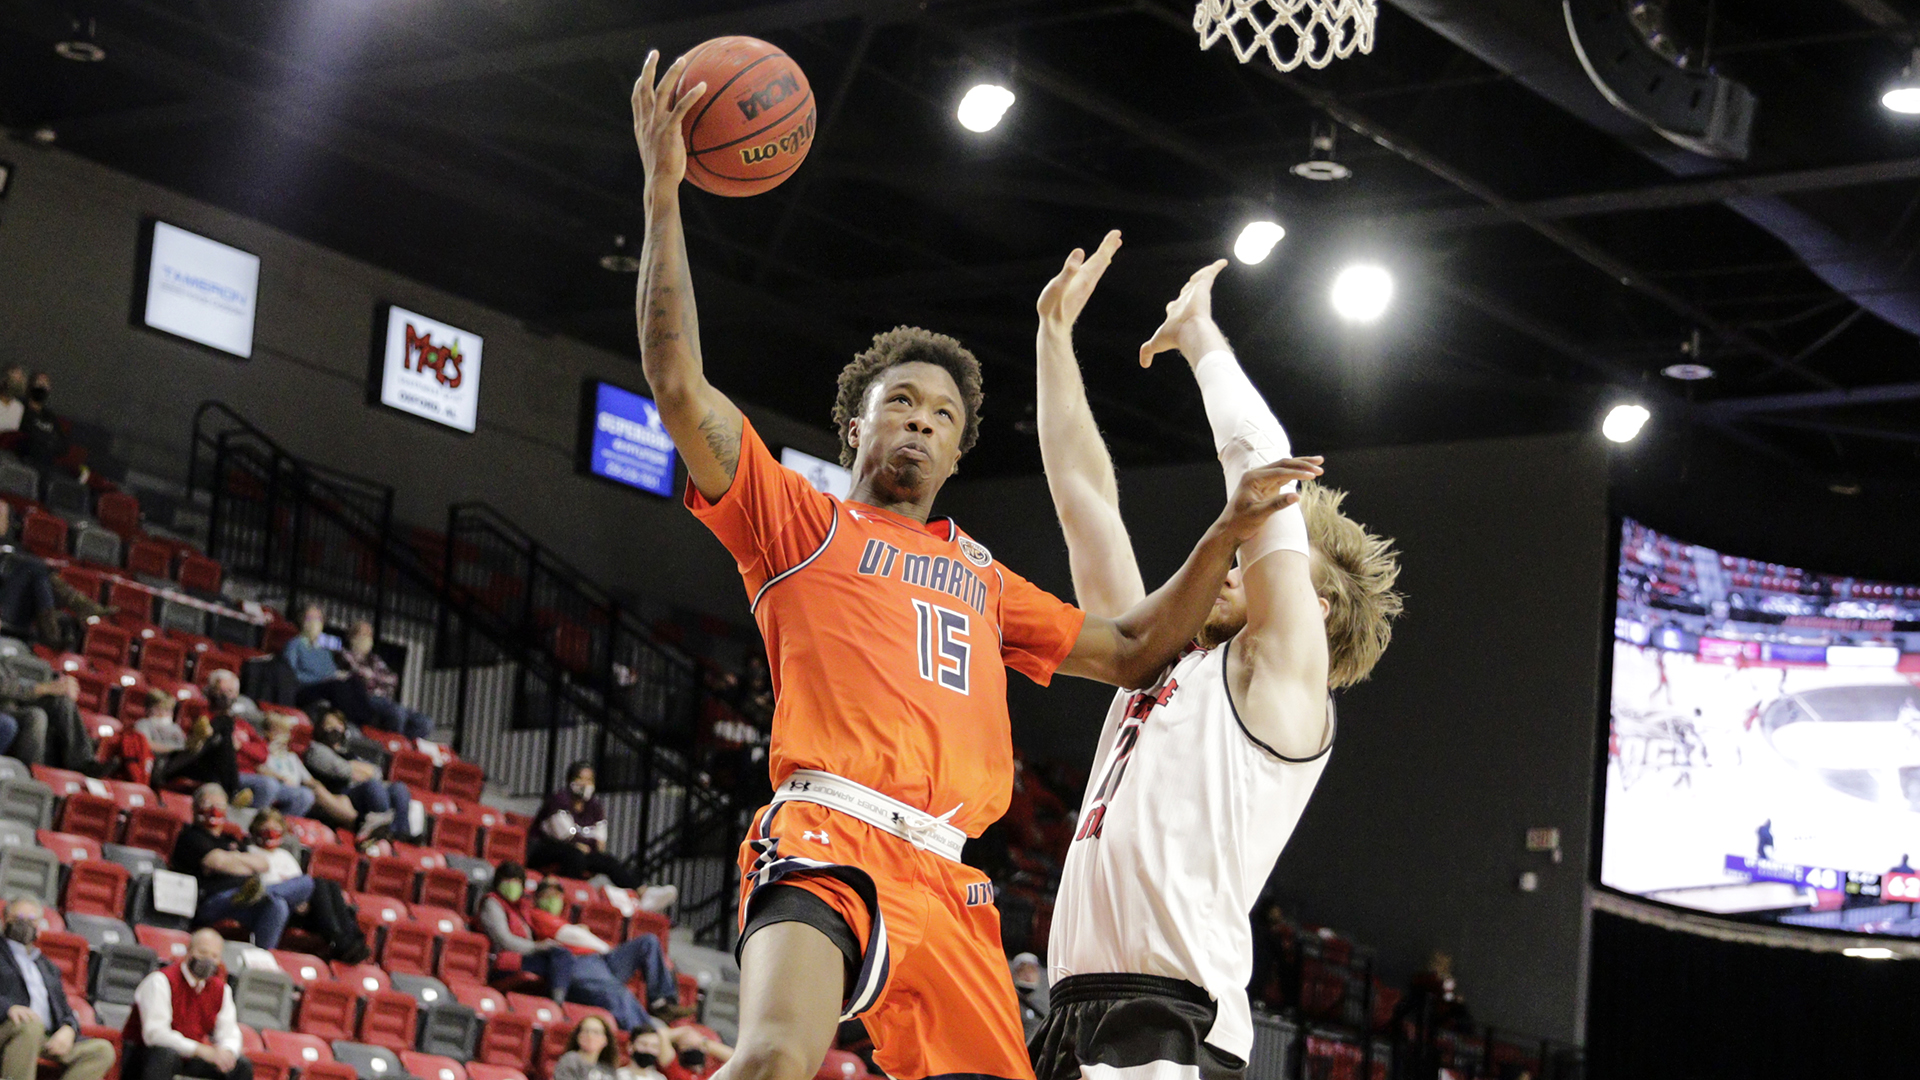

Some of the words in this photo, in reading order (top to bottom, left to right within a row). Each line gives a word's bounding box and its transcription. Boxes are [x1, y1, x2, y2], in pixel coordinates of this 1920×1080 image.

[737, 71, 800, 121] NCAA
[740, 107, 816, 165] Wilson
[858, 538, 901, 577] UT
[901, 552, 987, 616] MARTIN
[911, 597, 971, 696] 15
[813, 784, 855, 804] ARMOUR
[857, 798, 888, 818] UNDER
